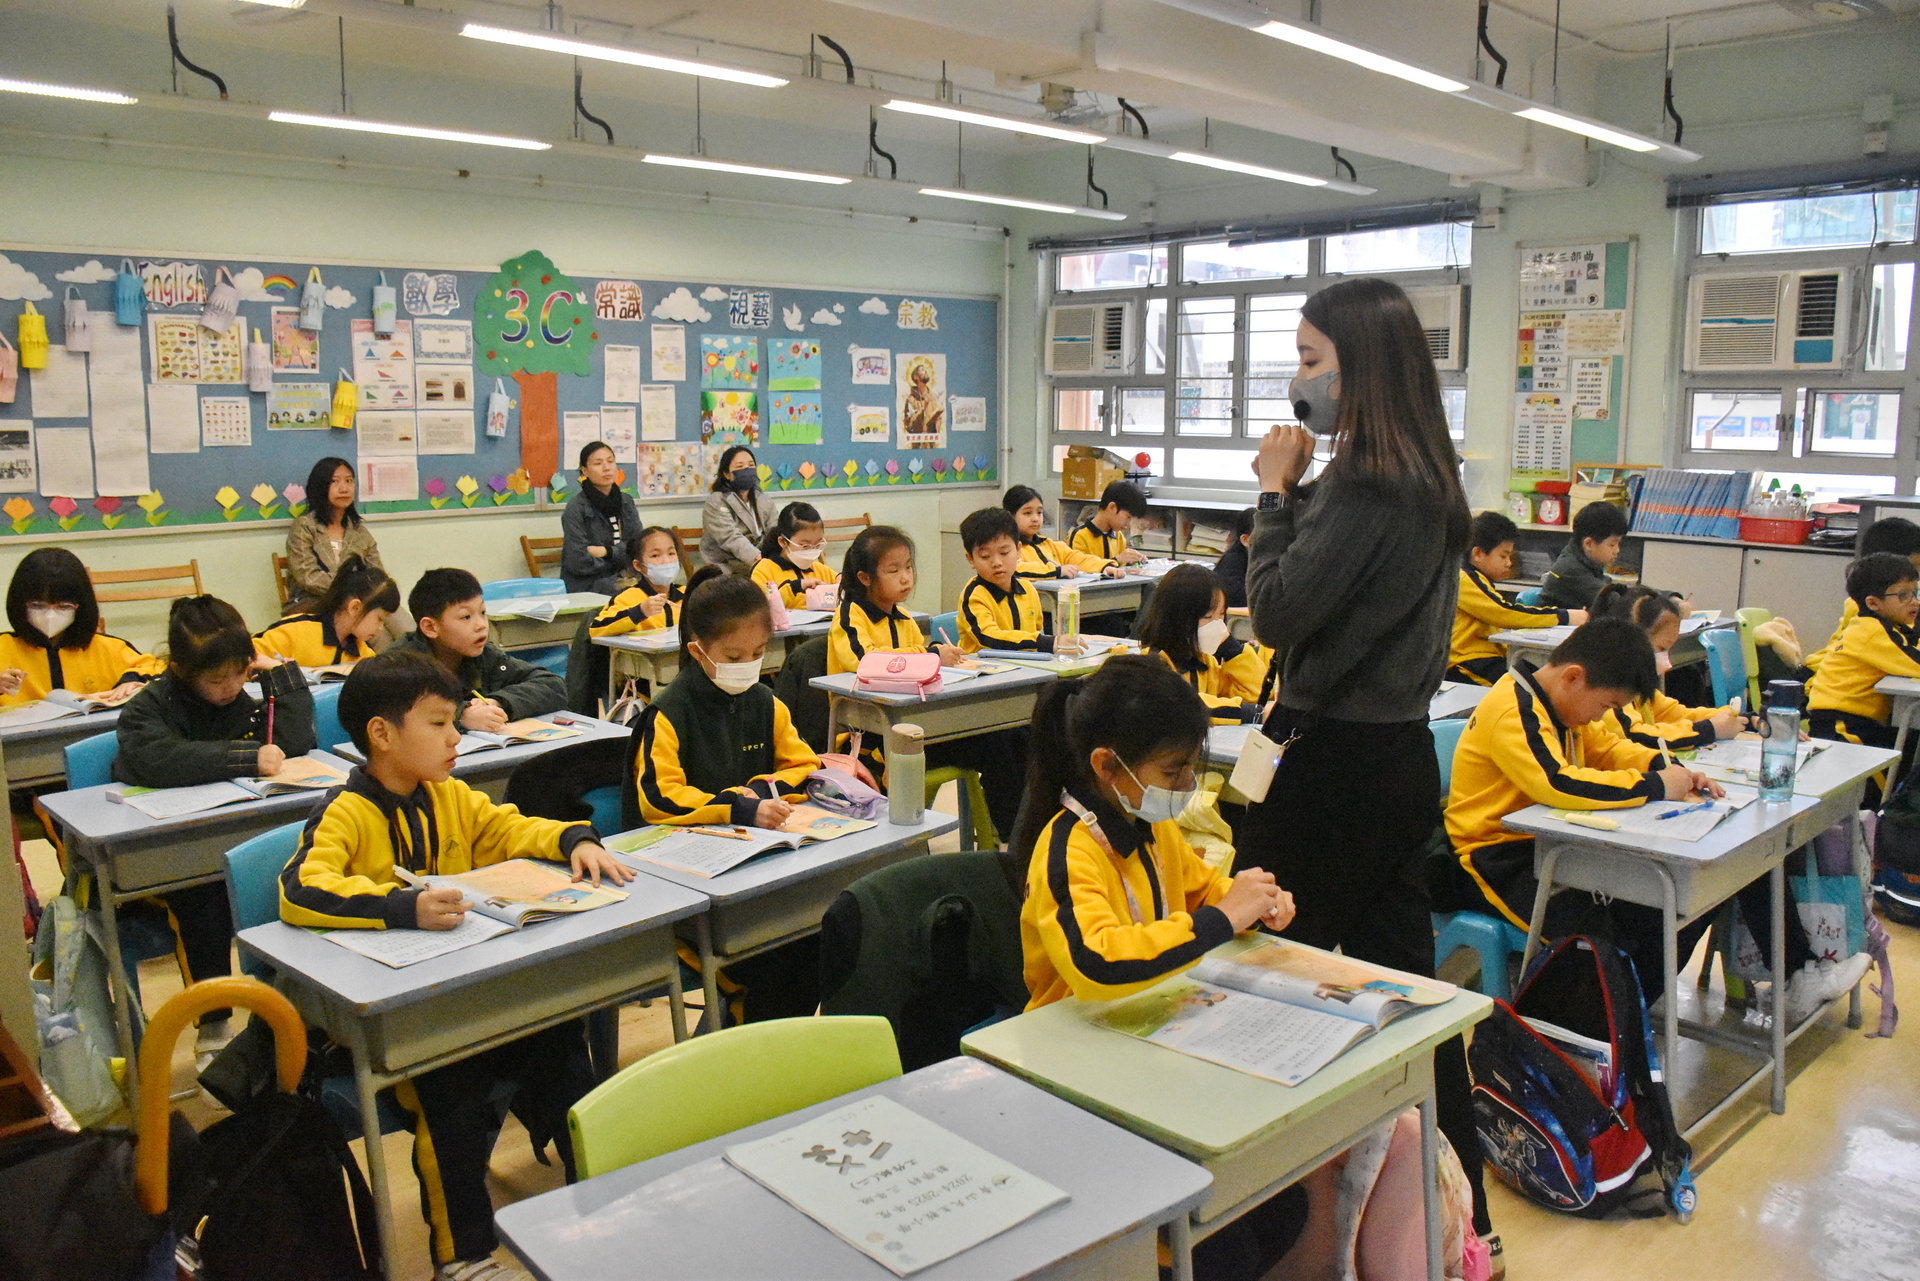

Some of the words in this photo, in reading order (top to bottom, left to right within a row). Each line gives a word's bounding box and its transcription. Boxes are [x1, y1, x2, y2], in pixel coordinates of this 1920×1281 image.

[404, 275, 458, 312] 數學
[596, 282, 642, 320] 常識
[730, 292, 769, 326] 視藝
[501, 288, 573, 345] 3C
[898, 302, 936, 328] 宗教
